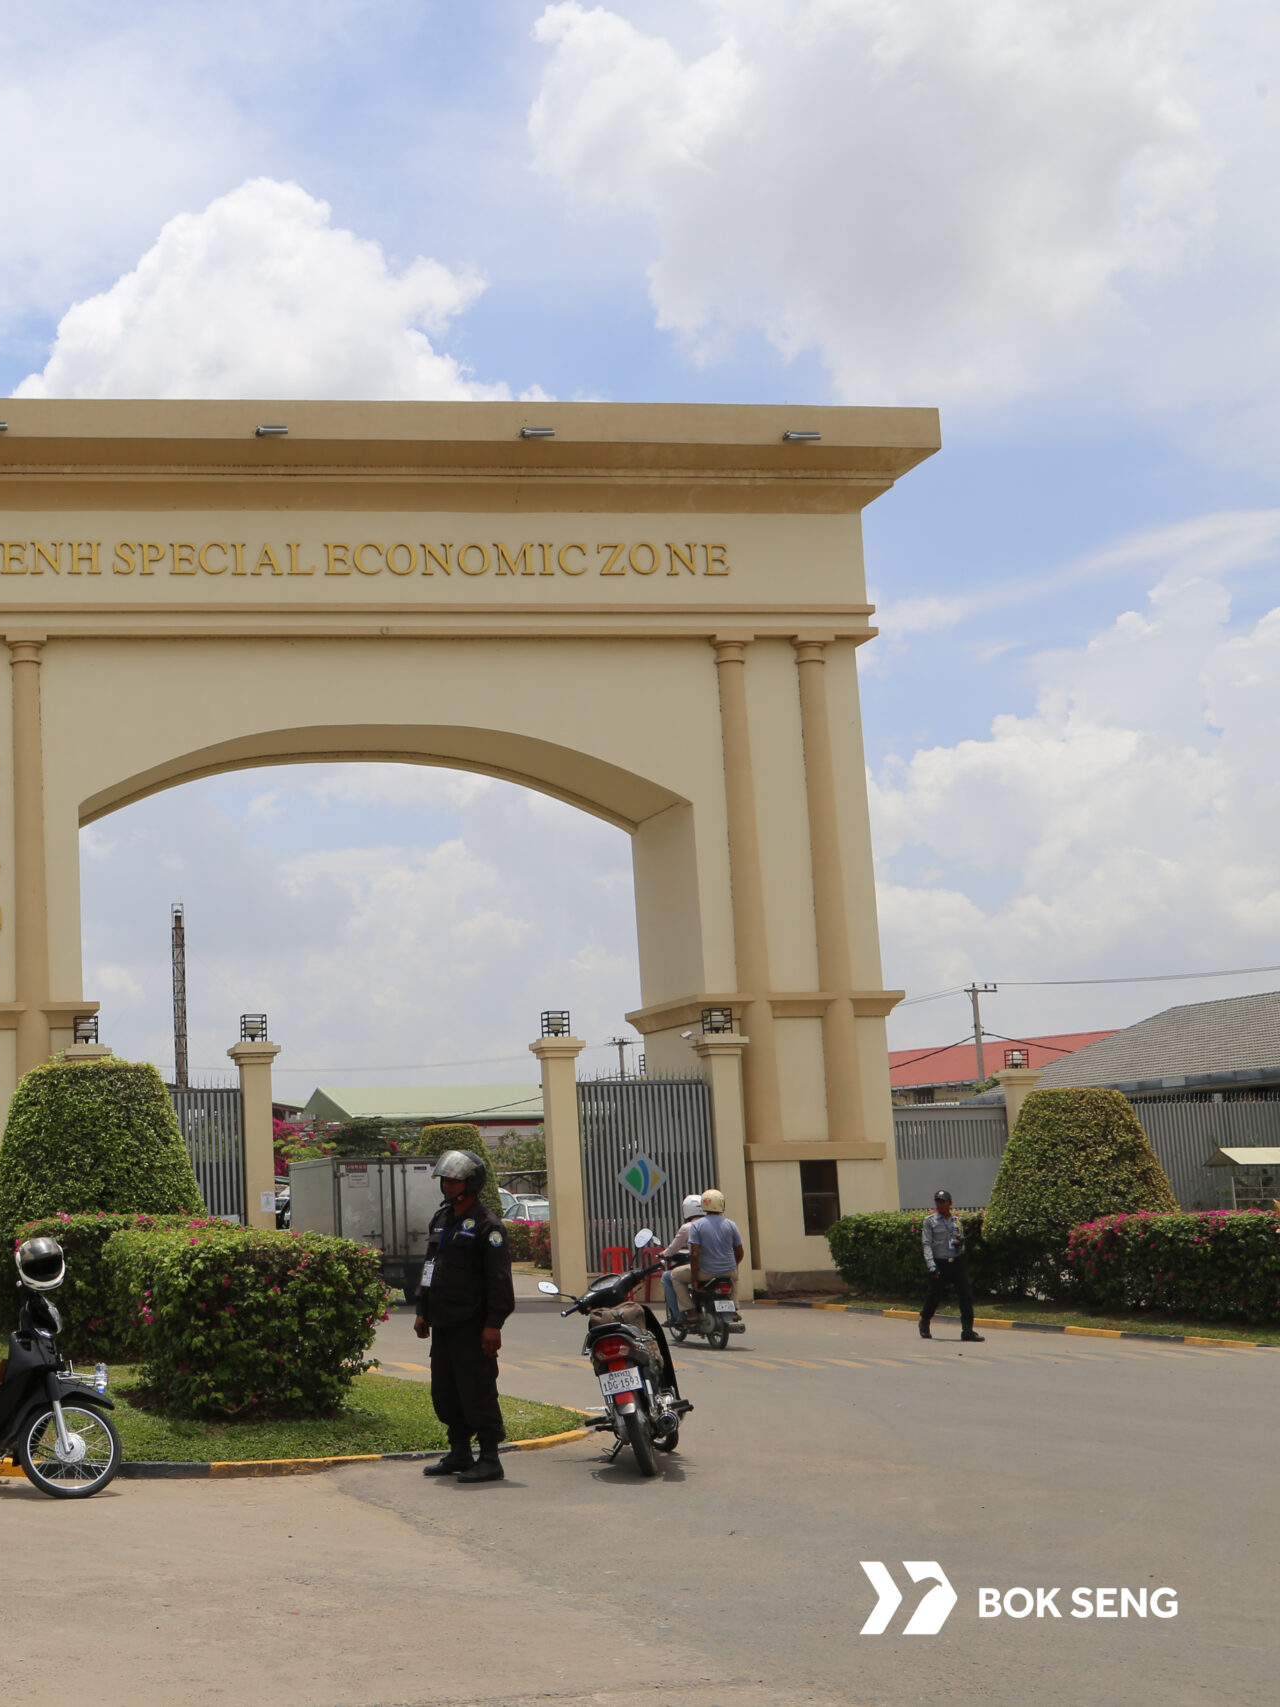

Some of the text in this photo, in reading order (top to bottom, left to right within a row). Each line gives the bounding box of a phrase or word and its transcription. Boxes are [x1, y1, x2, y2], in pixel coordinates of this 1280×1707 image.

[112, 540, 316, 578] SPECIAL
[323, 540, 588, 578] ECONOMIC
[596, 541, 732, 578] ZONE
